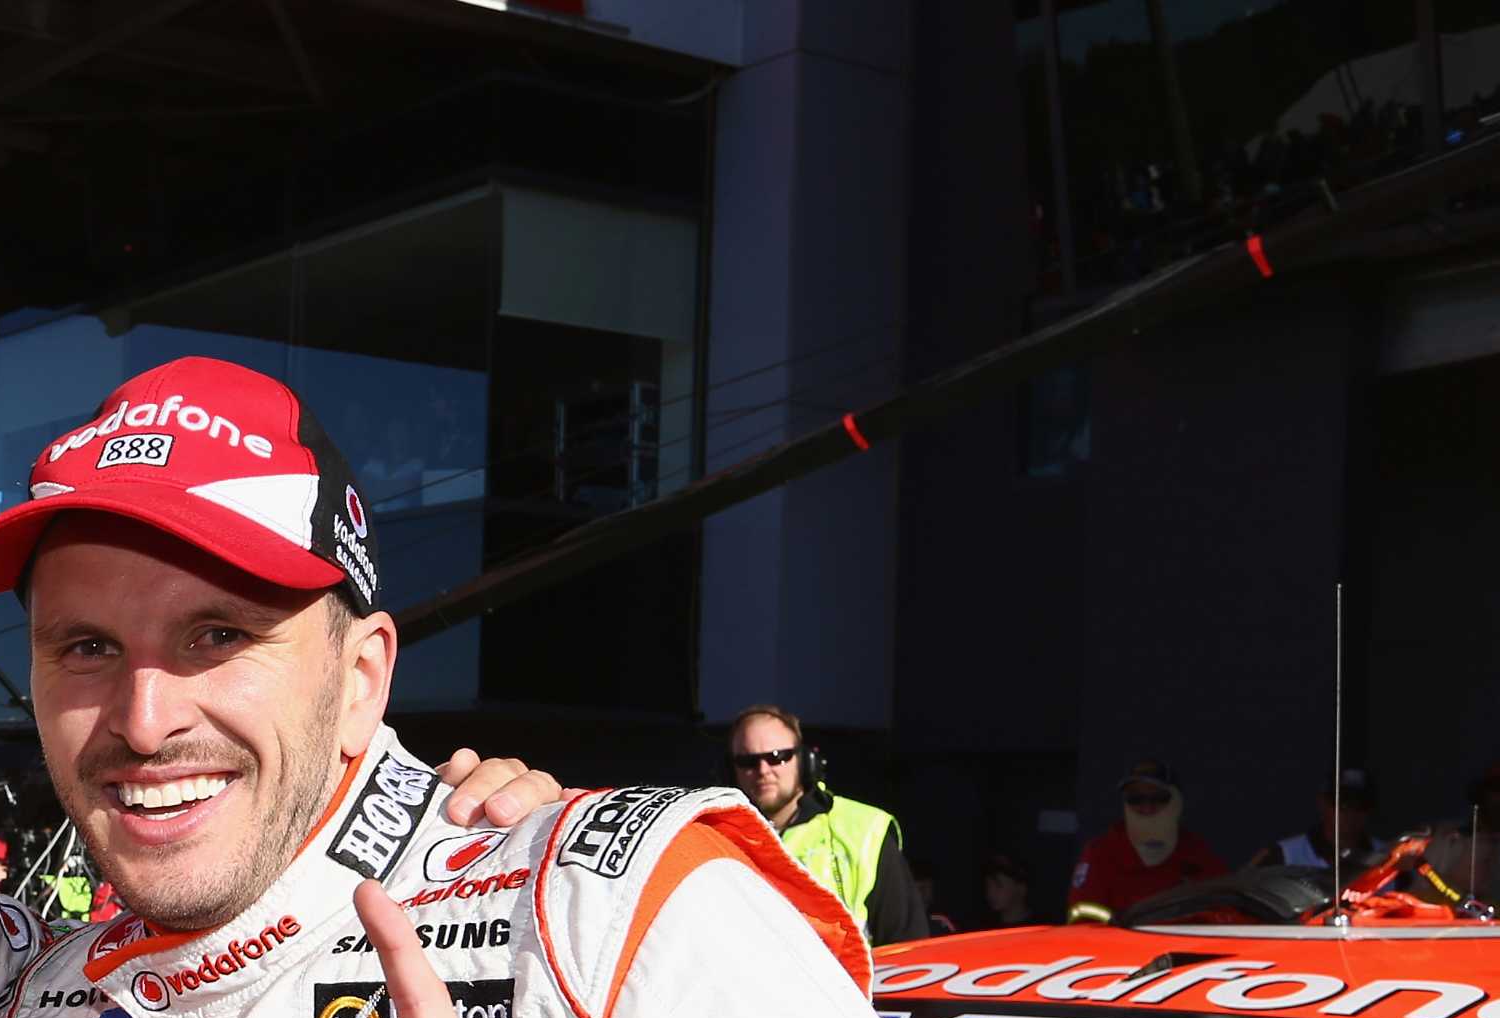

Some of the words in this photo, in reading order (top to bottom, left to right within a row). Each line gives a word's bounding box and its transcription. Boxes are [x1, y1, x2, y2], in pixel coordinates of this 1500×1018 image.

[48, 394, 274, 462] vodafone
[105, 437, 166, 462] 888
[164, 913, 302, 996] vodafone
[331, 918, 512, 954] SASUNG
